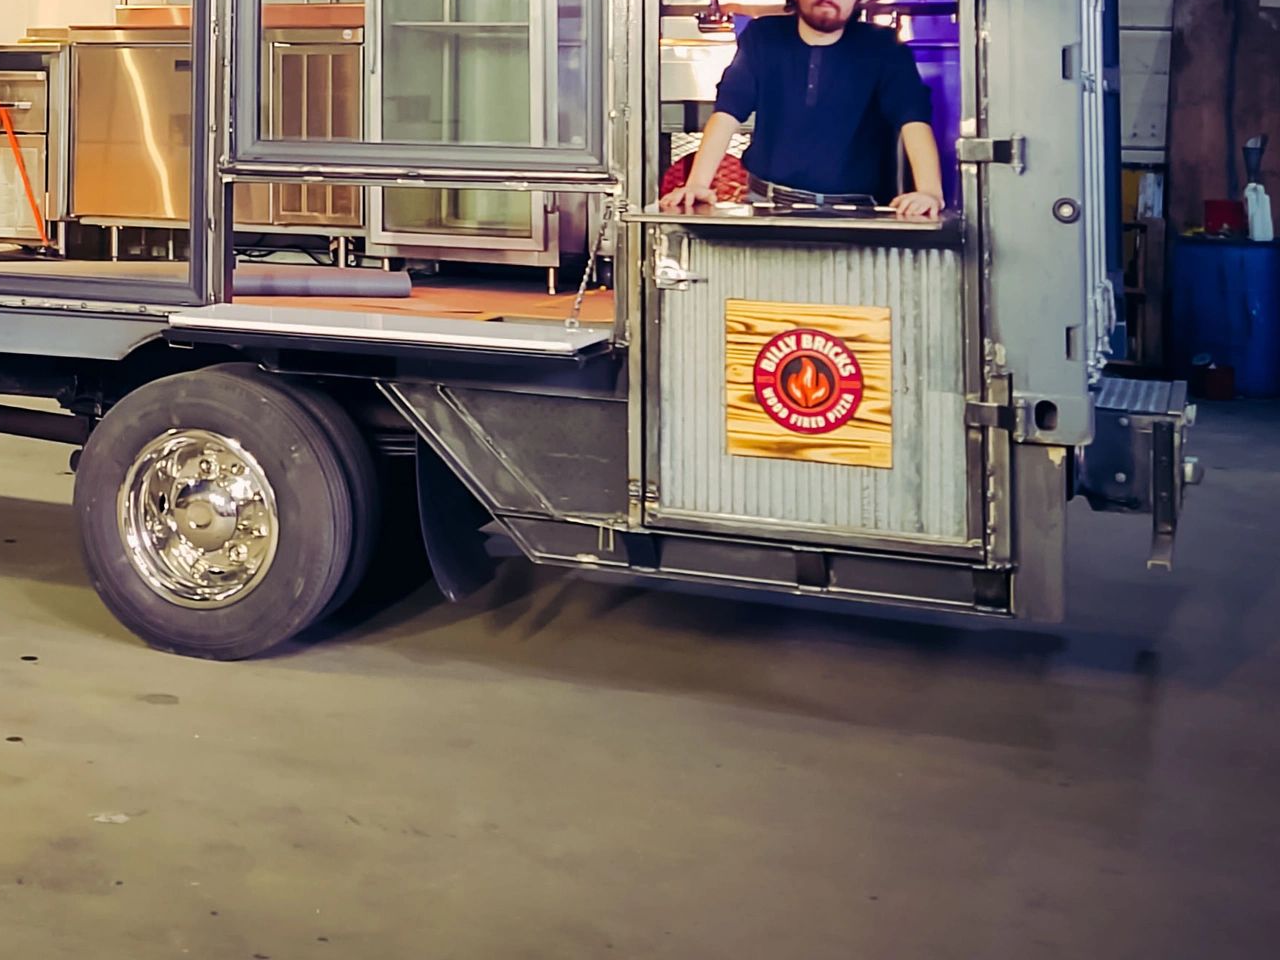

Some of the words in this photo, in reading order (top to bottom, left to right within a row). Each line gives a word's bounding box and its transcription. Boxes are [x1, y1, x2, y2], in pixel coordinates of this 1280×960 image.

[758, 334, 799, 373] BILLY
[801, 334, 856, 377] BRICKS
[761, 386, 790, 419] WOOD
[789, 414, 826, 428] FIRED
[826, 392, 855, 424] PIZZA
